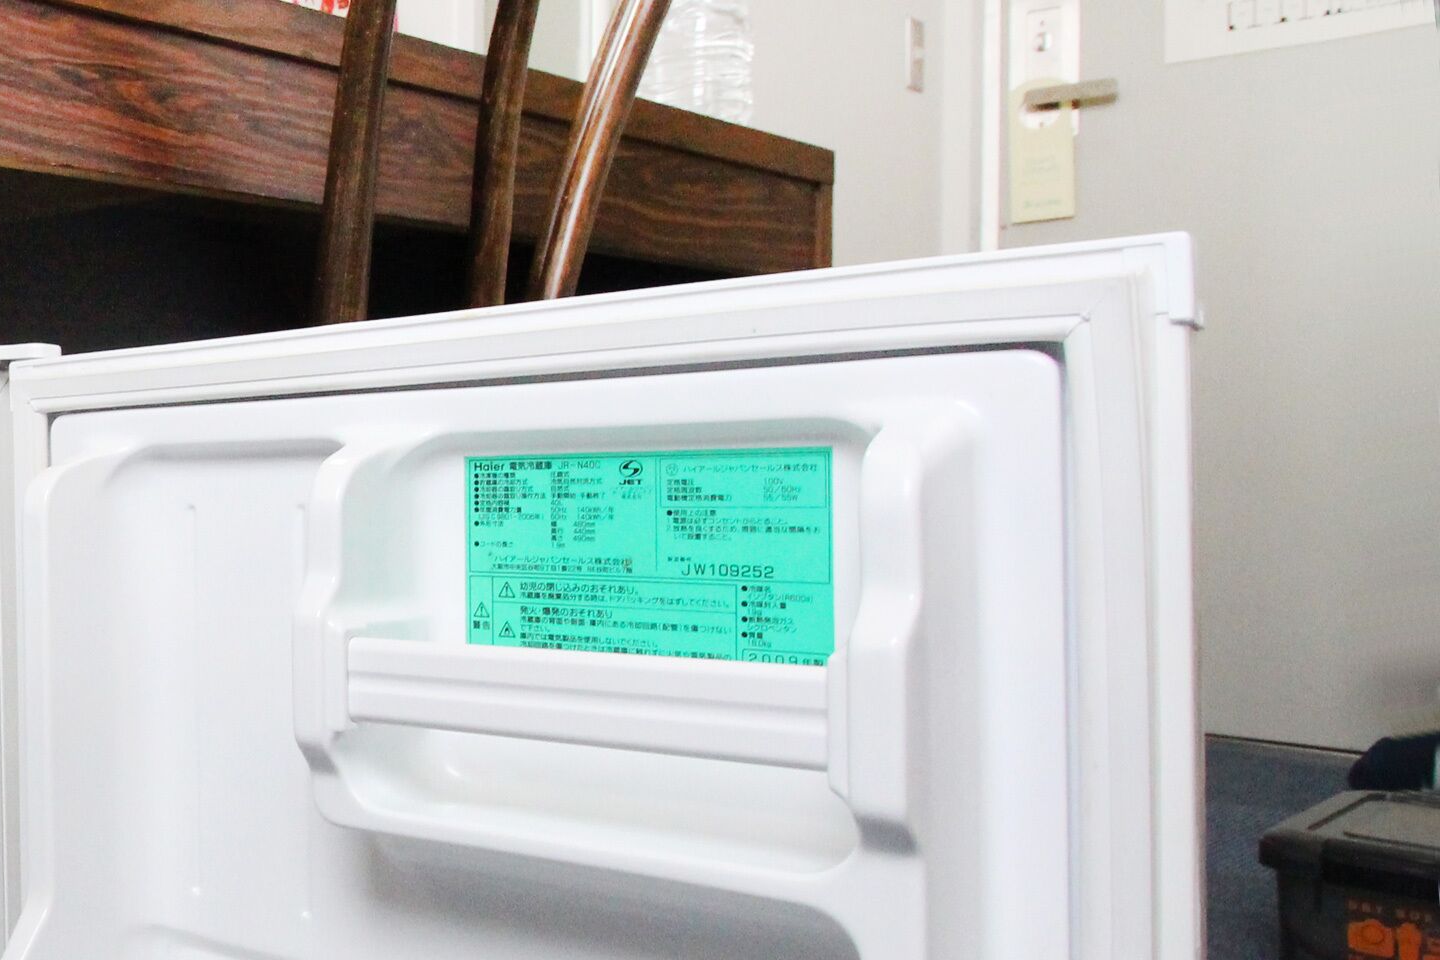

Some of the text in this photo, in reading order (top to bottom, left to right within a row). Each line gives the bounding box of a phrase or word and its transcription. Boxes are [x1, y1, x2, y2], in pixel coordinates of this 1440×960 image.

[474, 461, 505, 471] Haier
[509, 461, 552, 470] 電気冷蔵庫
[681, 563, 775, 579] JW109252
[520, 581, 639, 595] 幼児の閉じ込みのおそれあり。
